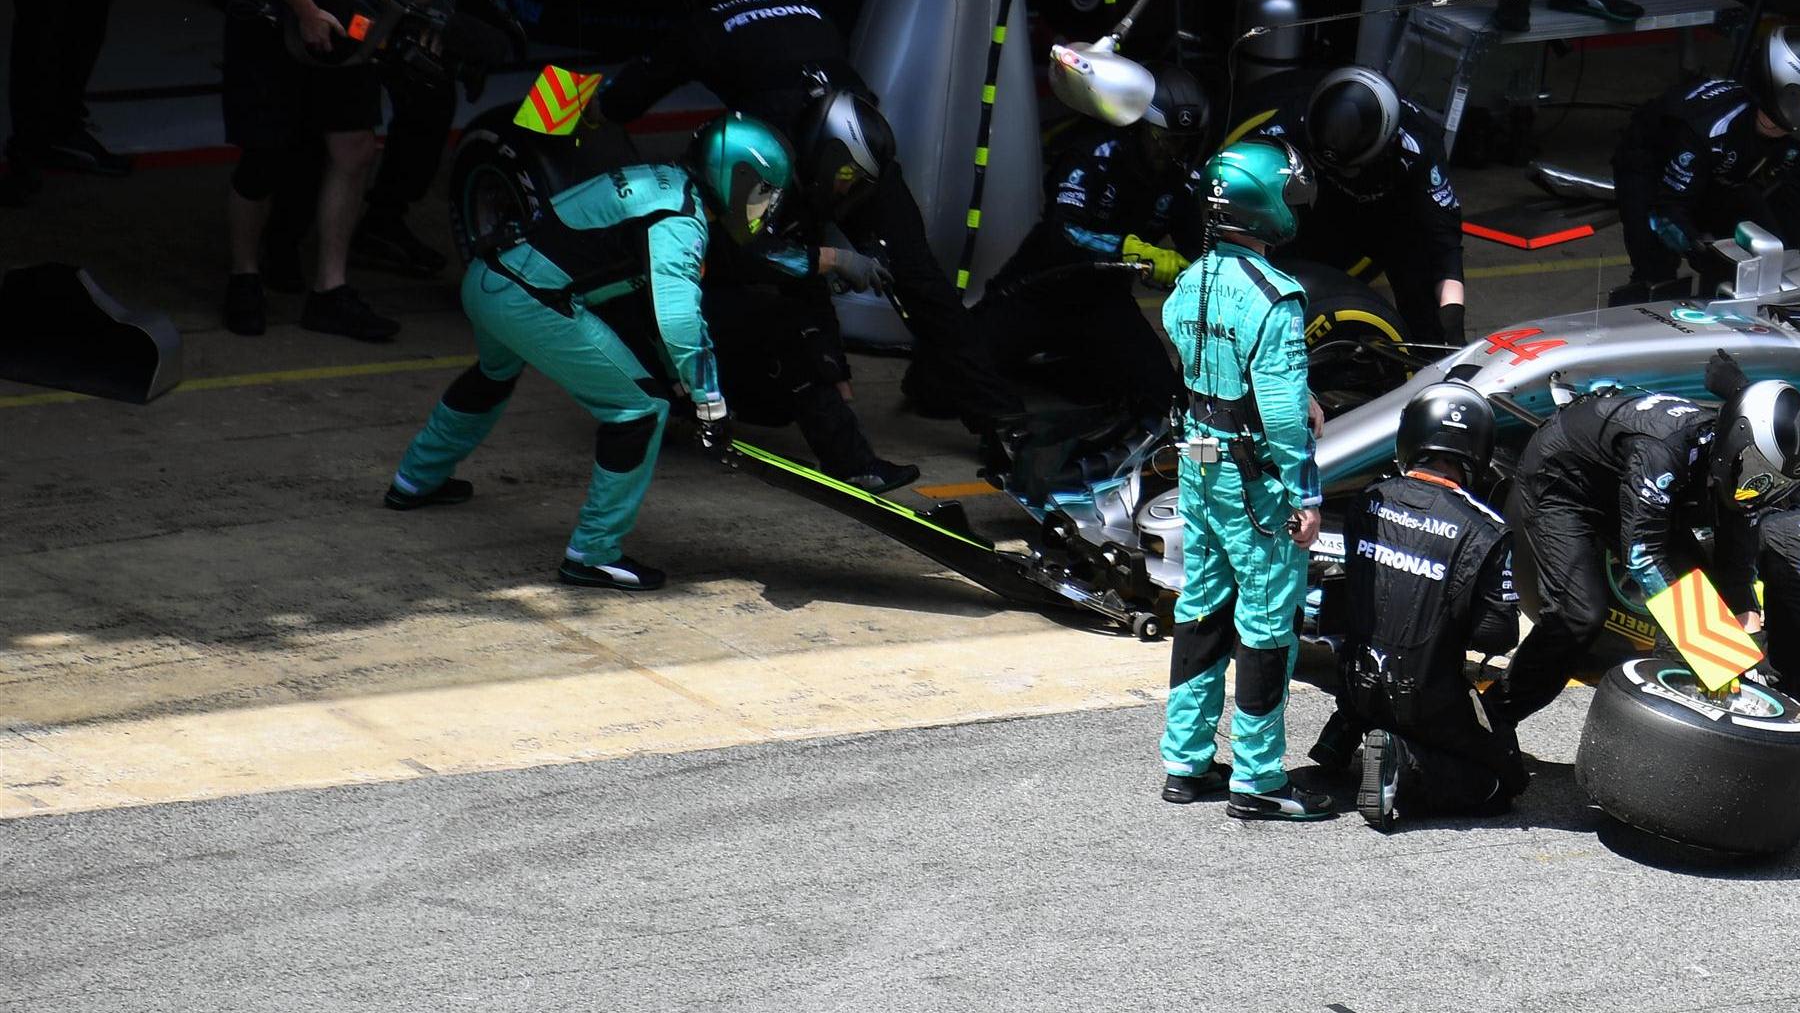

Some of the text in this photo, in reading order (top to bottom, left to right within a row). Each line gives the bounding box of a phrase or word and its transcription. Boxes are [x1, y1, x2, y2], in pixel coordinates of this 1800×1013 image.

[1484, 327, 1569, 366] 44
[1367, 500, 1458, 539] Mercedes-AMG
[1356, 538, 1446, 582] PETRONAS
